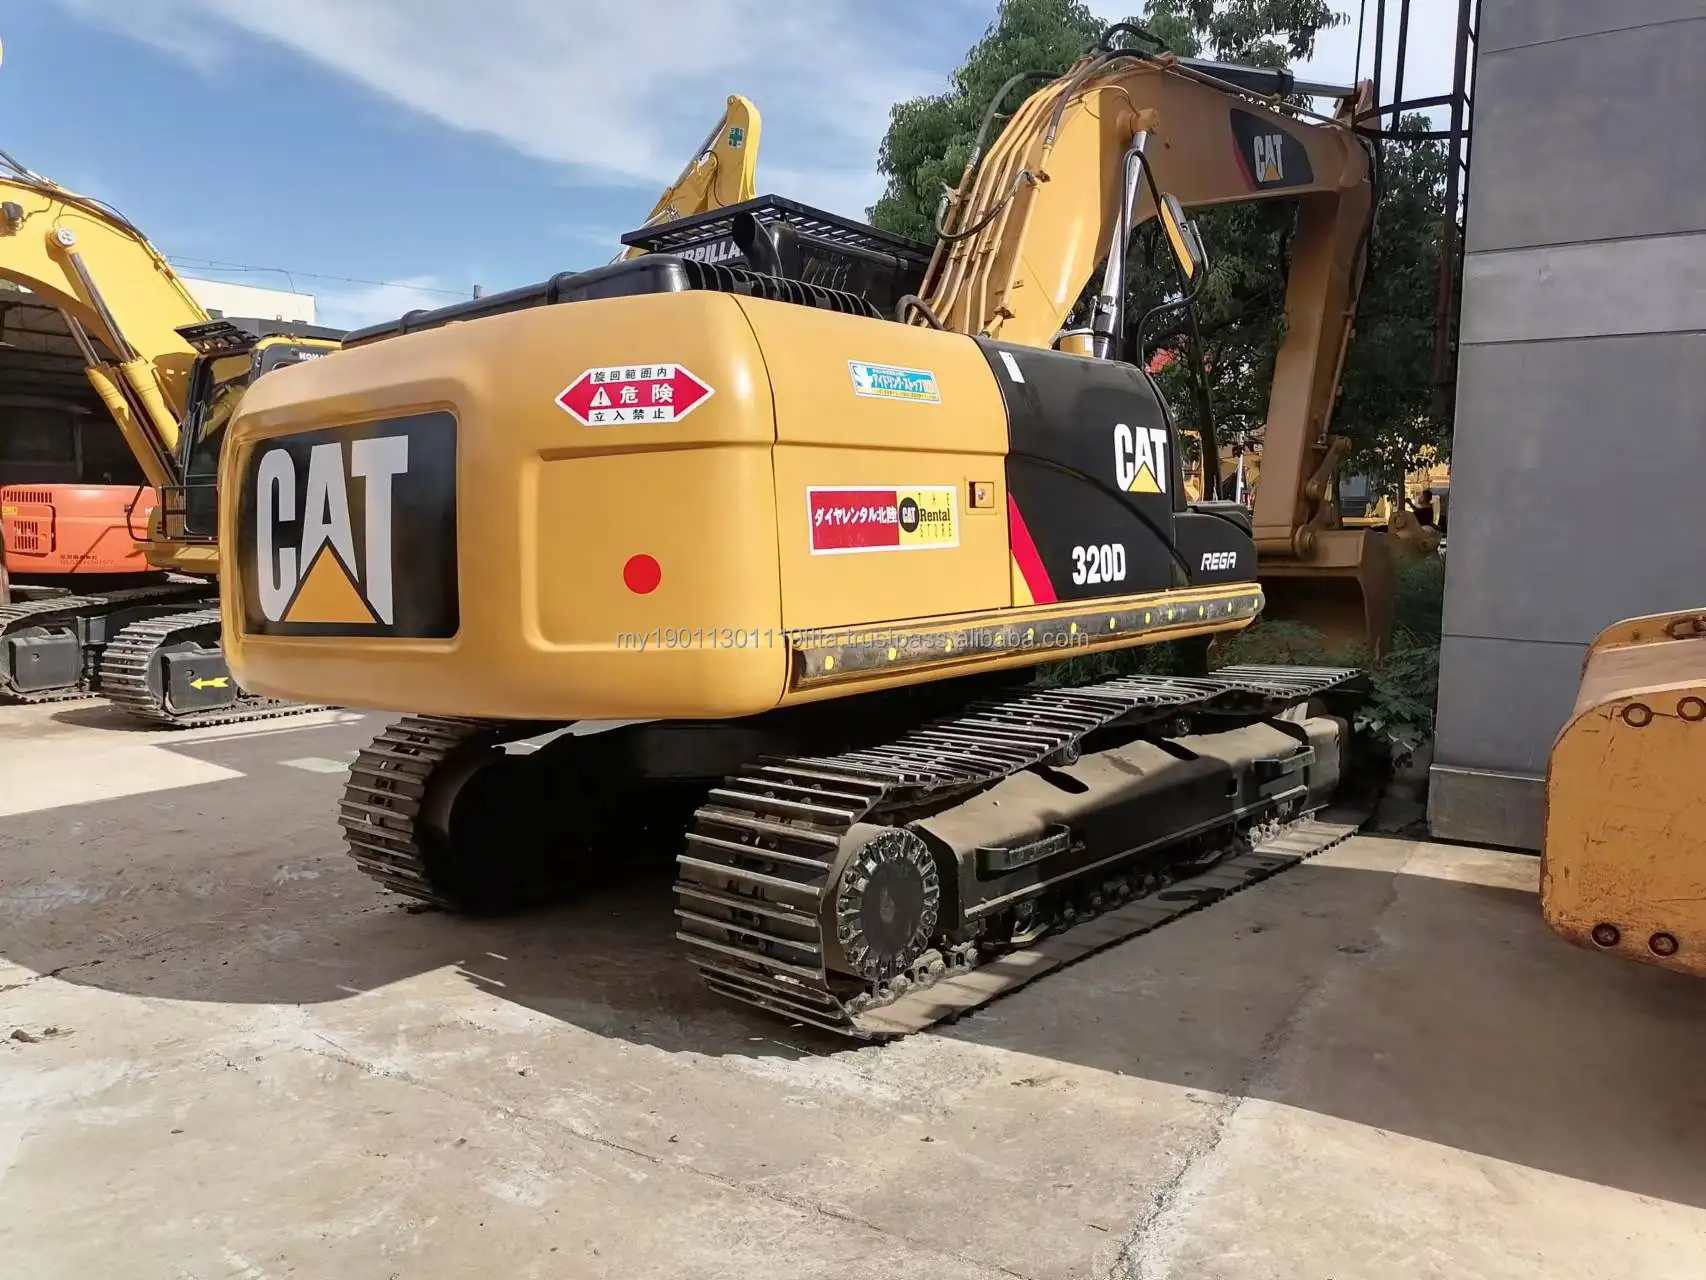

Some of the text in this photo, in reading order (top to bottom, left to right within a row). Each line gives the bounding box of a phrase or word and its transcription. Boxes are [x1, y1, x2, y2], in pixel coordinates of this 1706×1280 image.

[1253, 134, 1284, 183] CAT
[594, 367, 668, 383] 旋回範囲内
[619, 383, 675, 405] 危険
[593, 408, 666, 423] 立入禁止
[1113, 423, 1167, 494] CAT
[814, 505, 898, 527] ダイヤレンタル北陸
[902, 506, 951, 524] CAT Rental
[256, 434, 409, 626] CAT
[1071, 543, 1127, 585] 320D
[1200, 551, 1237, 571] REGA
